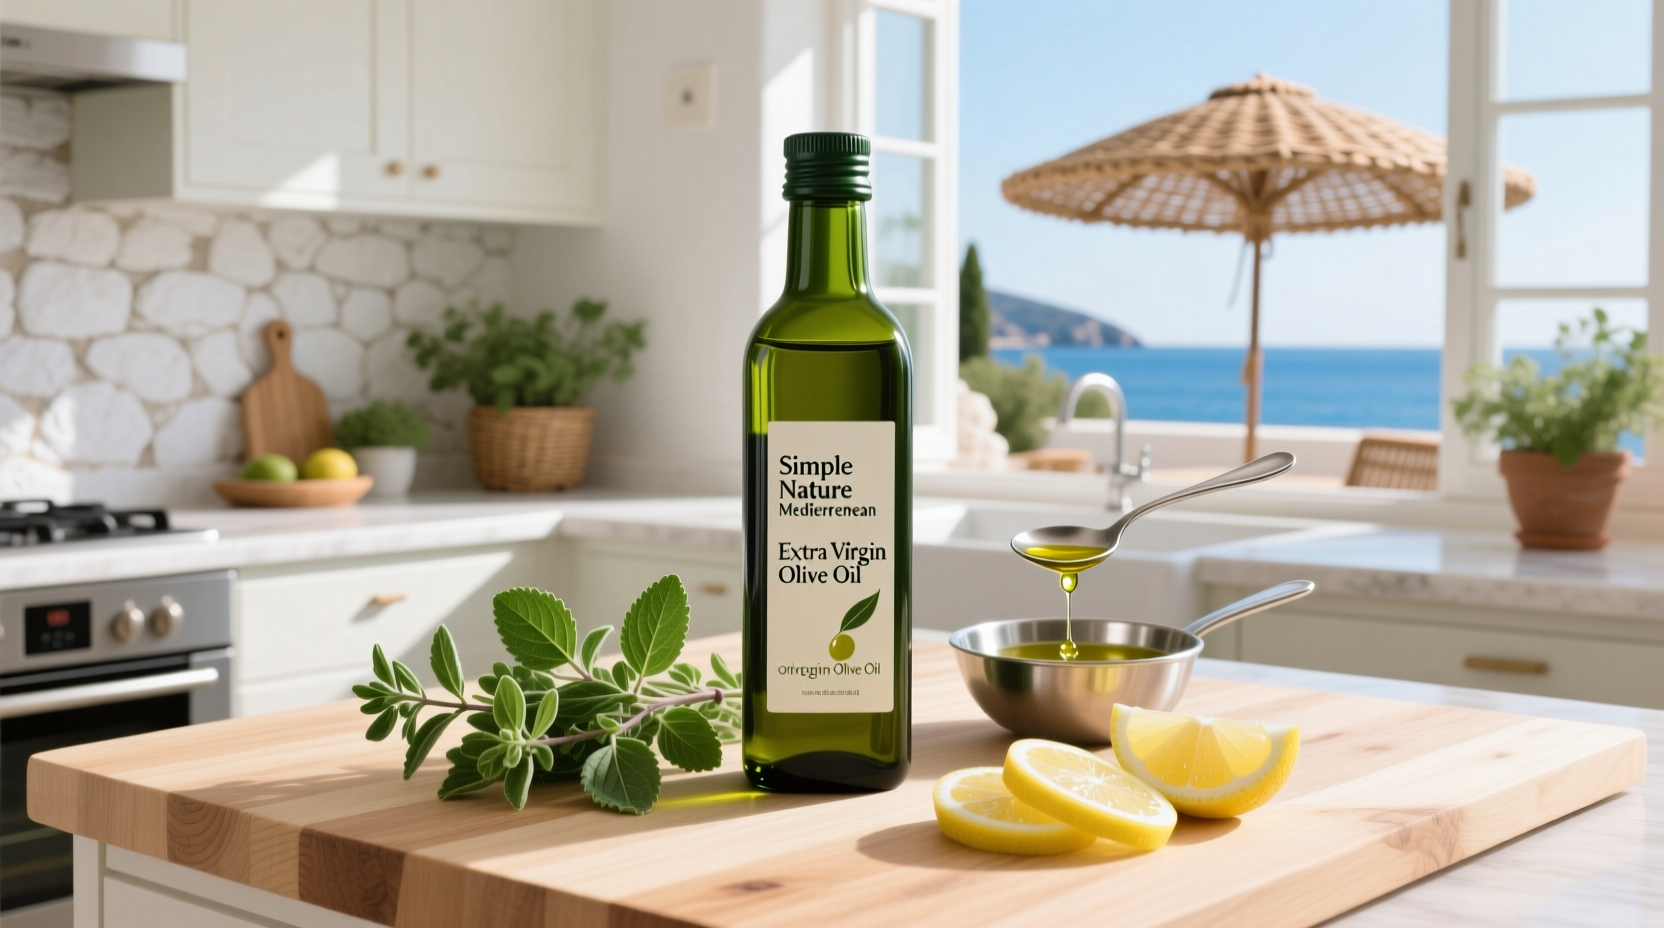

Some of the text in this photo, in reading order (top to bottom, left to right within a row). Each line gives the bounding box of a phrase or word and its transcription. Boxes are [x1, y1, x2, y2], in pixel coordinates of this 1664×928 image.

[779, 455, 853, 481] Simple
[779, 480, 853, 499] Nature
[779, 502, 877, 517] Medierrenean
[778, 541, 887, 566] Extra Virgin
[778, 565, 862, 584] Olive Oil
[833, 662, 862, 676] Olive
[864, 662, 881, 675] Oil
